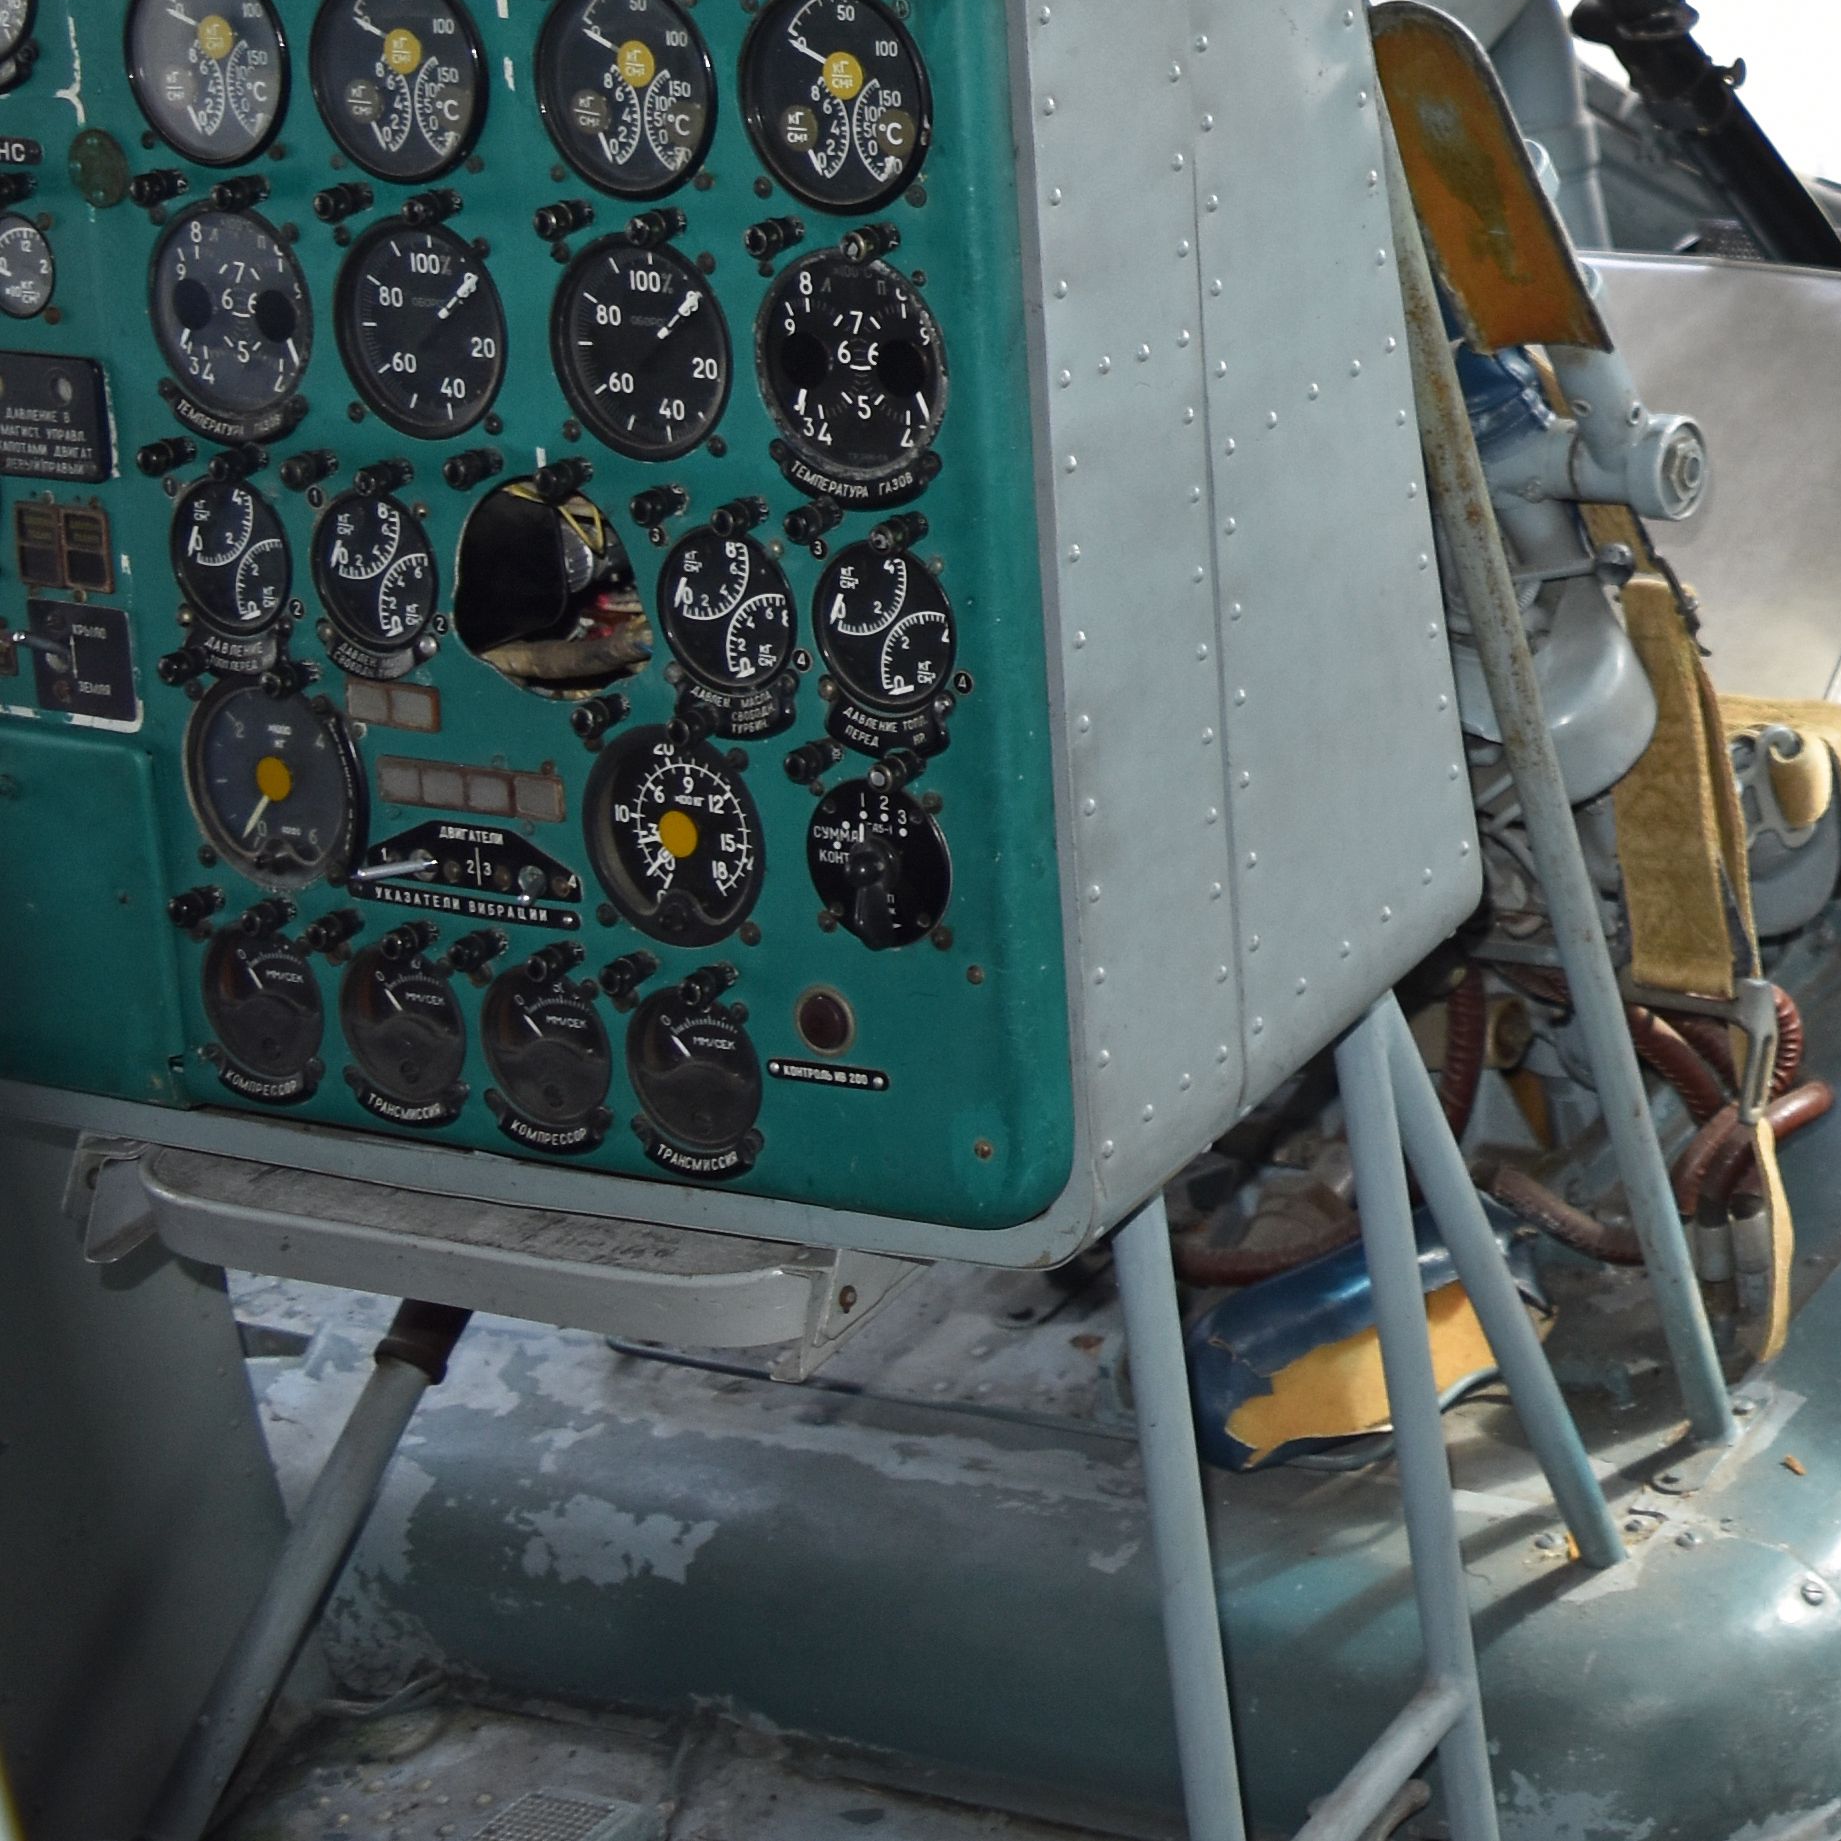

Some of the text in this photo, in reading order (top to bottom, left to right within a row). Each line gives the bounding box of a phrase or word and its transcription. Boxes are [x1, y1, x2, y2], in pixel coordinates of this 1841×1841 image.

[243, 2, 263, 18] 100
[837, 5, 855, 21] 50
[433, 18, 454, 34] 100
[666, 31, 688, 47] 100
[875, 41, 898, 57] 100
[248, 50, 268, 65] 150
[437, 68, 459, 82] 150
[669, 81, 691, 97] 150
[878, 90, 901, 106] 150
[410, 252, 452, 276] 100%
[630, 269, 674, 295] 100%
[800, 271, 813, 295] 8
[379, 286, 403, 307] 80
[596, 304, 621, 326] 80
[850, 311, 862, 335] 7
[784, 318, 795, 336] 9
[471, 337, 496, 359] 20
[837, 340, 851, 364] 6
[392, 351, 416, 373] 60
[692, 357, 718, 380] 20
[440, 377, 465, 399] 40
[608, 372, 634, 393] 60
[659, 398, 685, 420] 40
[857, 395, 871, 419] 5
[804, 417, 815, 436] 3
[818, 422, 832, 446] 4
[790, 460, 913, 498] ТЕМПЕРАТУРА ГАЗОВ
[843, 706, 898, 733] ДАВЛЕНИЕ
[845, 725, 880, 747] ПЕРЕД
[654, 785, 665, 803] 6
[683, 776, 694, 793] 9
[614, 804, 629, 822] 10
[708, 794, 724, 814] 12
[880, 796, 889, 810] 2
[898, 810, 907, 825] 3
[439, 826, 504, 845] ДВИГАТЕЛИ
[720, 833, 735, 852] 15
[813, 825, 859, 842] СУММА
[381, 848, 576, 888] 1 2 3 4
[712, 861, 728, 880] 18
[375, 887, 548, 921] УКАЗАТЕЛИ ВИБРАЦИИ
[224, 1071, 297, 1096] КОМПРЕССОР
[849, 1073, 868, 1085] 200
[368, 1092, 441, 1121] ТРАНСМИССИЯ
[510, 1119, 588, 1146] КОМПРЕССОР
[656, 1143, 738, 1172] ТРАНСМИССИЯ
